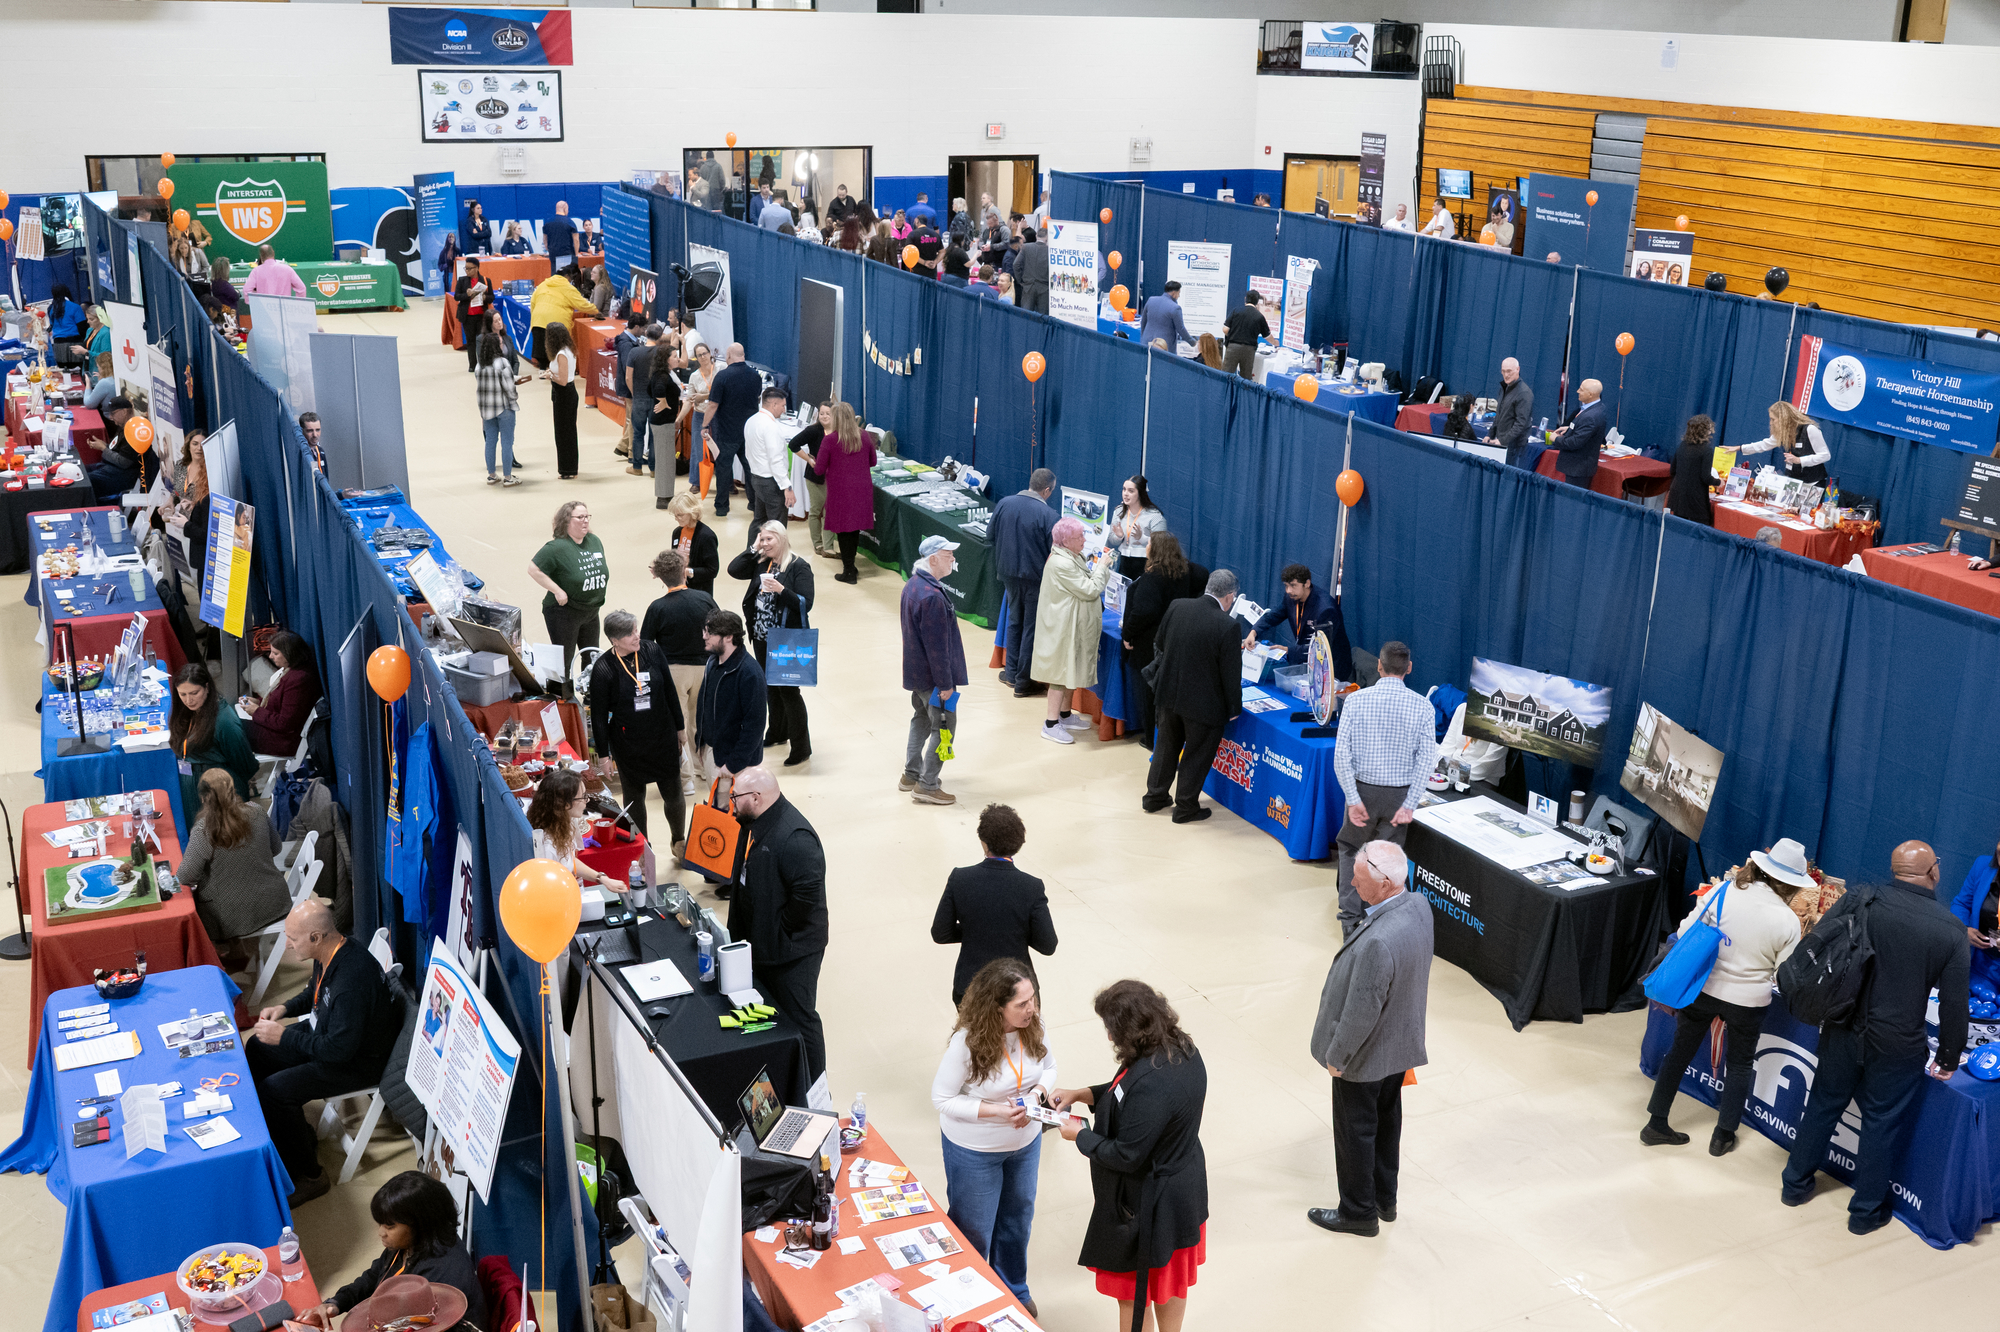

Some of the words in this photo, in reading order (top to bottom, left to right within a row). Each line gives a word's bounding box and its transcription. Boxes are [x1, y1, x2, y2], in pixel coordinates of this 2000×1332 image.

[1306, 46, 1353, 57] KNIGHTS
[227, 189, 273, 197] INTERSTATE
[232, 206, 273, 229] IWS
[1536, 207, 1554, 215] Business
[1555, 210, 1573, 218] solutions
[1536, 213, 1546, 221] here,
[1547, 215, 1559, 223] there,
[1559, 217, 1585, 226] everywhere.
[1050, 254, 1093, 269] BELONG
[1059, 248, 1080, 256] WHERE
[322, 282, 336, 292] IWS
[315, 297, 376, 306] interstatewaste.com
[1912, 369, 1943, 387] Victory
[1944, 376, 1962, 389] Hill
[1876, 377, 1926, 397] Therapeutic
[1927, 388, 1994, 413] Horsemanship
[1891, 398, 1907, 407] Finding
[1923, 405, 1940, 414] Healing
[1940, 409, 1957, 418] through
[1906, 415, 1921, 425] (845)
[1921, 418, 1950, 431] 843-0020
[579, 562, 594, 571] need
[585, 569, 601, 577] these
[582, 574, 606, 591] CATS
[1217, 746, 1246, 773] CAR
[1234, 743, 1252, 762] Wash
[1265, 746, 1281, 762] Foam
[1285, 757, 1303, 773] Wash
[1267, 807, 1290, 829] WASH
[1416, 865, 1471, 908] FREESTONE
[1416, 884, 1485, 936] ARCHITECTURE
[485, 1052, 504, 1083] HEALTHCARE
[486, 1064, 499, 1087] CAREERS
[1754, 1105, 1797, 1140] SAVING
